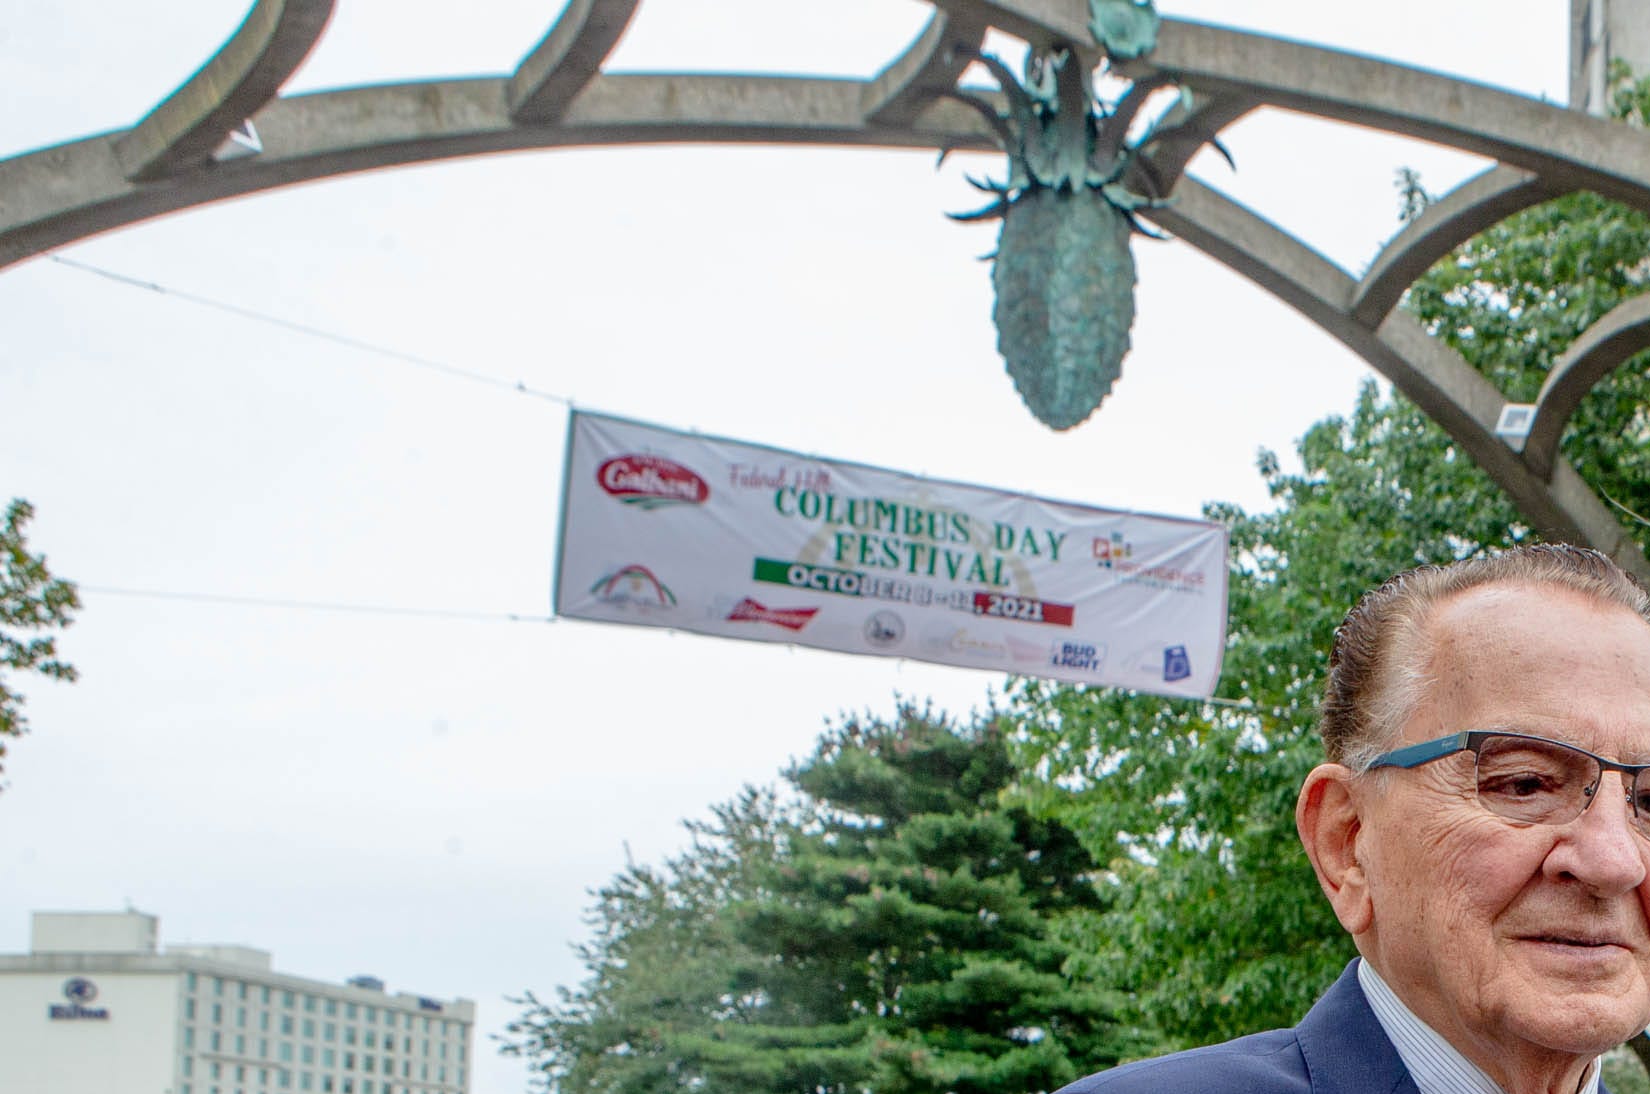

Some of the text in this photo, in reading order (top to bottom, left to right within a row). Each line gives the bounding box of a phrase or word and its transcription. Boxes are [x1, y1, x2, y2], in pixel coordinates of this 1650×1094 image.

[774, 486, 1067, 562] COLUMBUS DAY
[834, 531, 1011, 588] FESTIVAL
[1053, 654, 1100, 672] LIGHT
[1062, 642, 1097, 657] BUD
